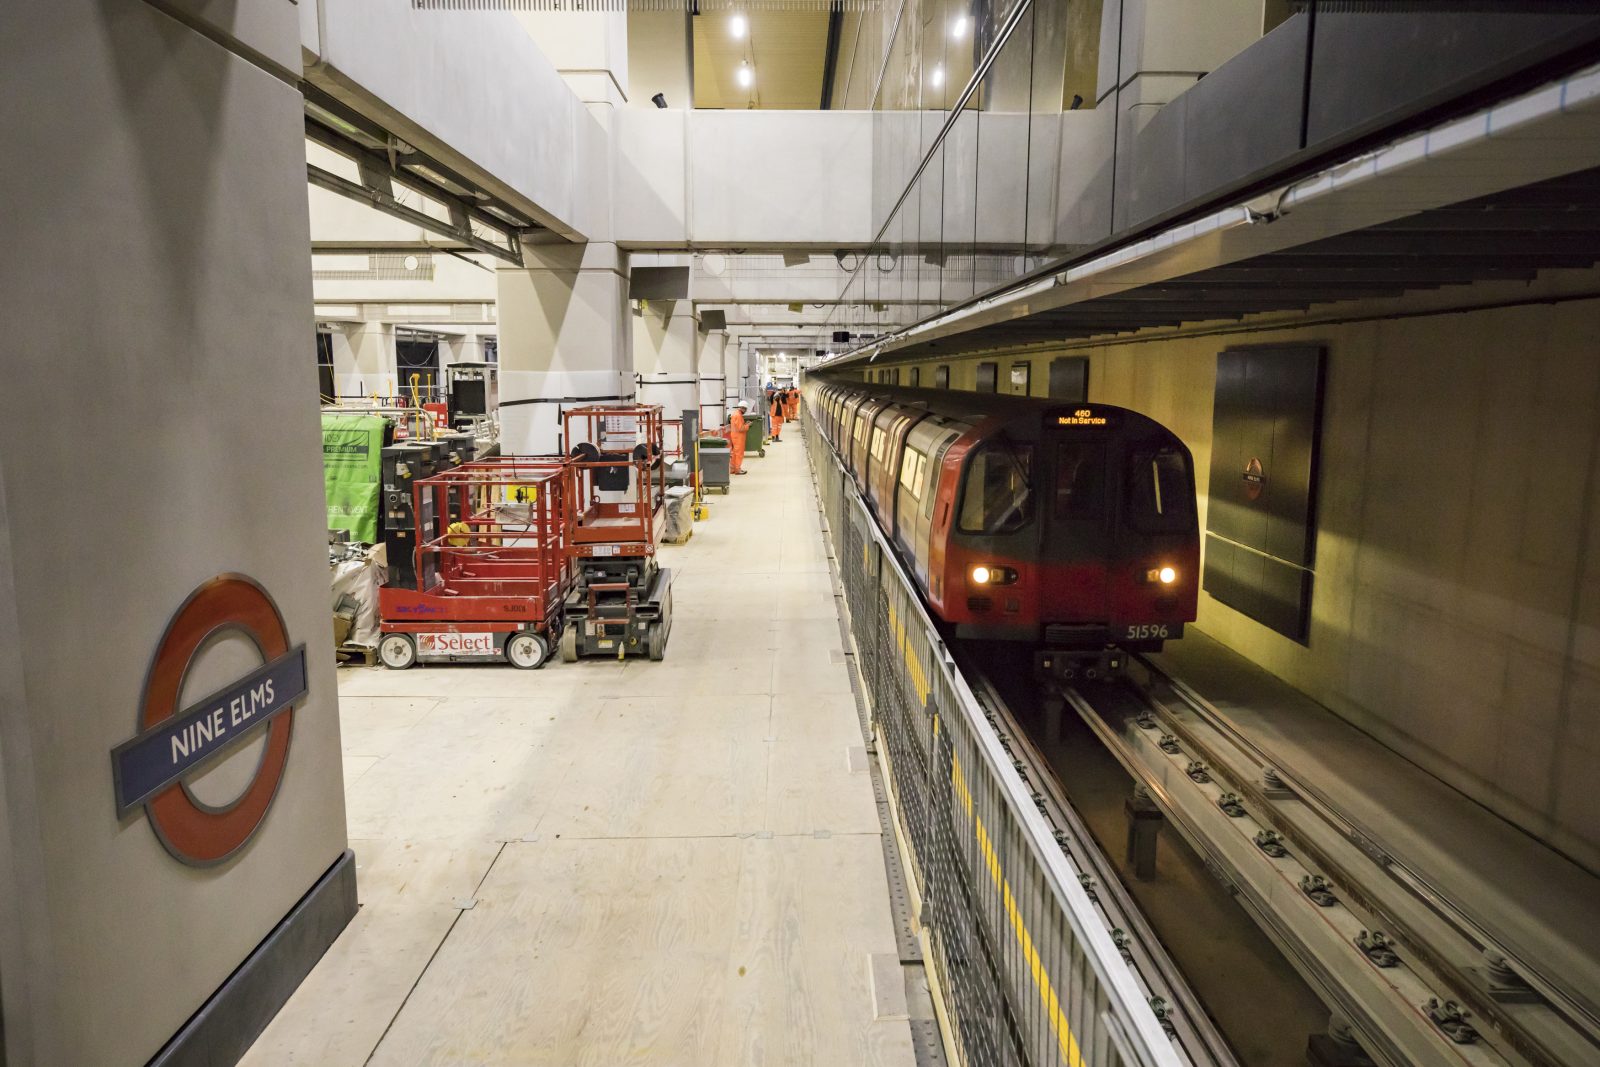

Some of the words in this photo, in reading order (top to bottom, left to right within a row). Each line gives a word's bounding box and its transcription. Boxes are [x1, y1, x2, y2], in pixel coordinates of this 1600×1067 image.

[1127, 624, 1168, 639] 51596
[438, 635, 491, 650] Select
[170, 708, 225, 765] NINE
[231, 679, 275, 726] ELMS
